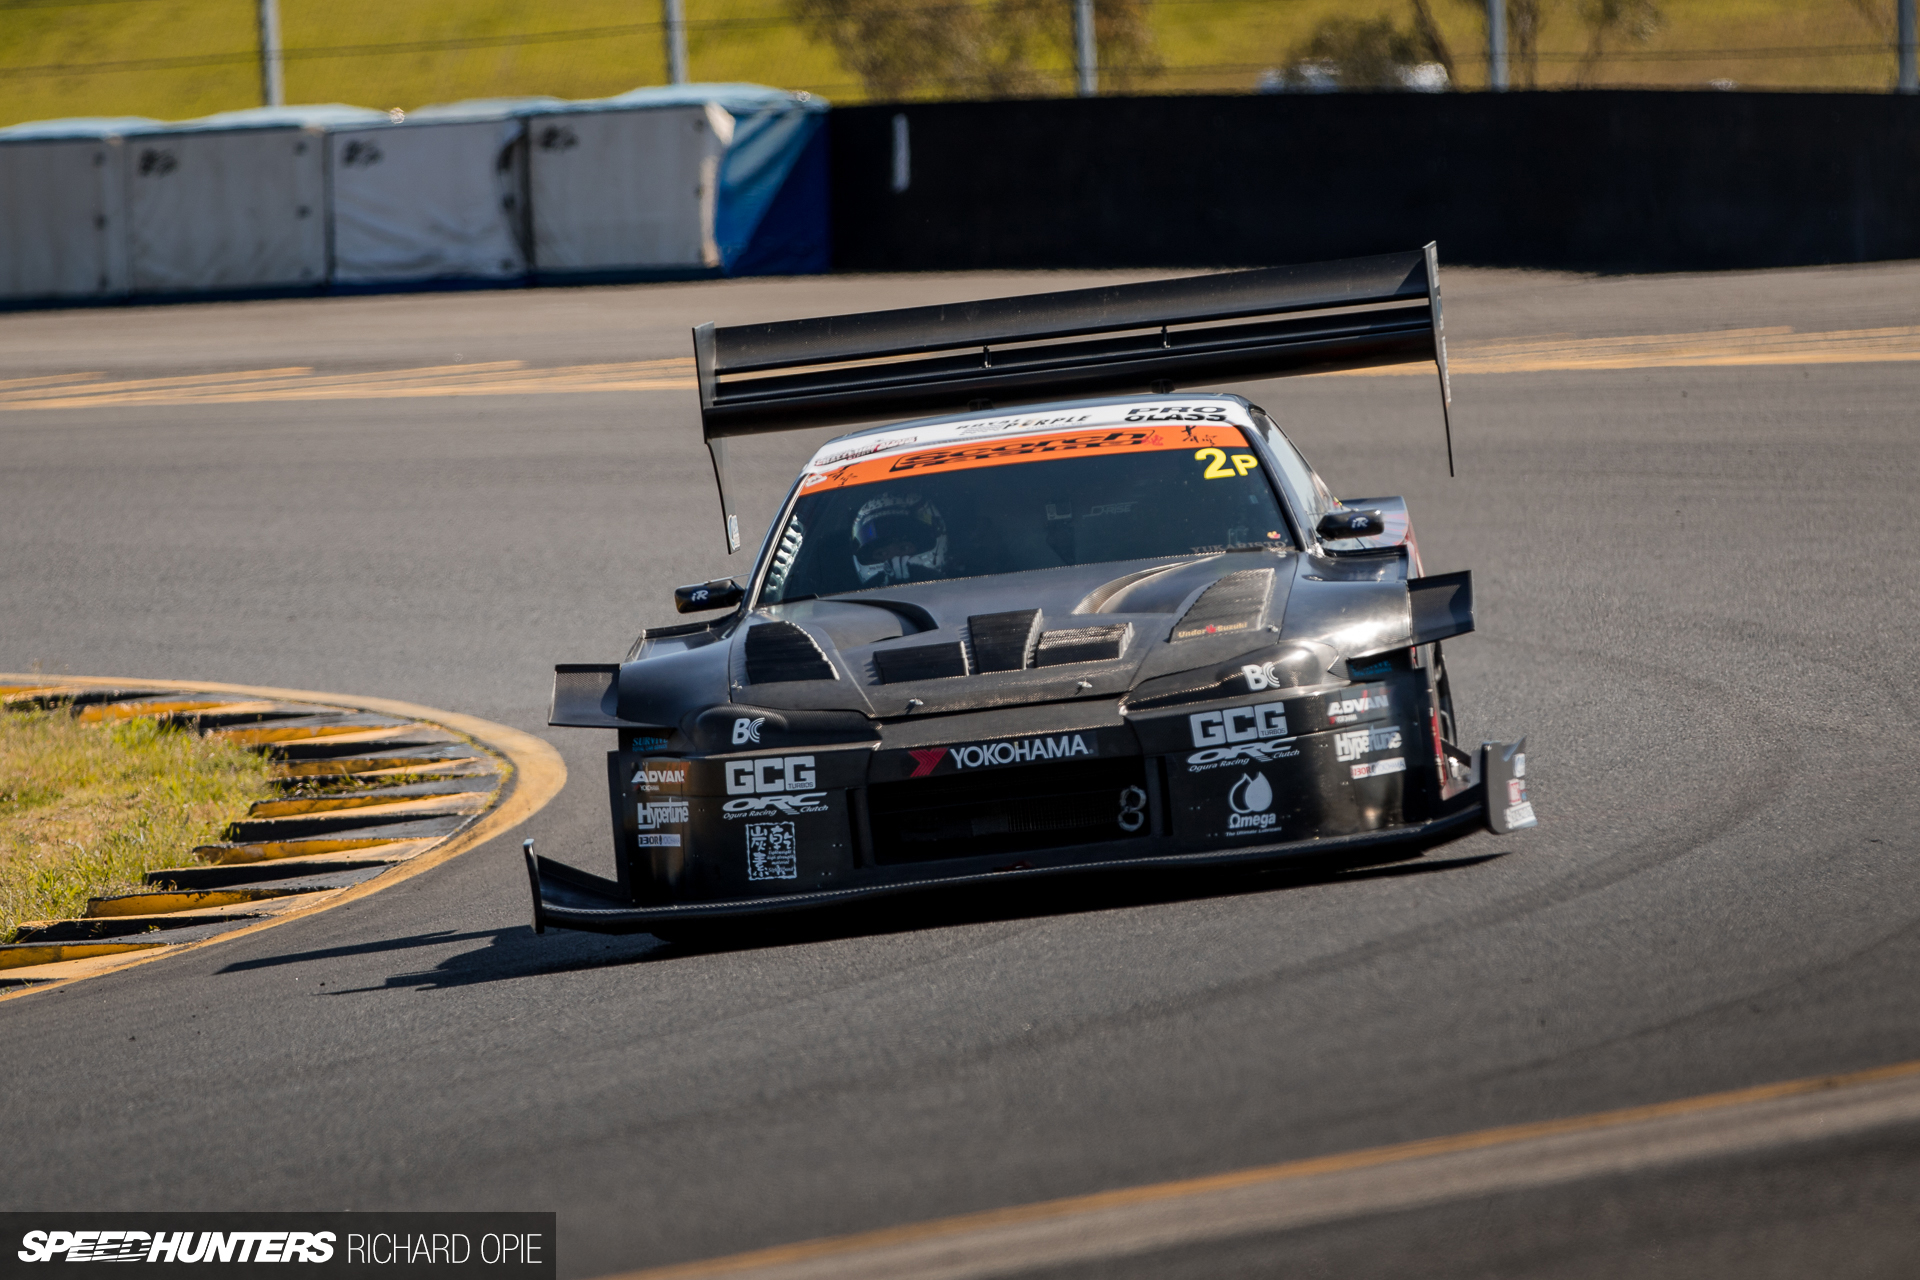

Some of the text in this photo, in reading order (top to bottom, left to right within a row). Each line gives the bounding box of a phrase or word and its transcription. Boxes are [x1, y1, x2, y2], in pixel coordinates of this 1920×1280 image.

[1003, 414, 1092, 430] PURPLE
[1124, 414, 1228, 422] CLASS
[1127, 406, 1227, 415] PRO
[1194, 447, 1259, 480] 2P
[1327, 694, 1390, 716] ADVAN
[1190, 701, 1288, 748] GCG
[1261, 727, 1286, 736] TURBOS
[950, 734, 1089, 769] YOKOHAMA
[1187, 736, 1298, 763] ORC
[1334, 724, 1402, 762] Hypertune
[1188, 749, 1300, 772] Ogura Racing Clutch
[631, 769, 685, 783] ADVAN
[725, 755, 816, 795] GCG
[637, 797, 689, 830] Hypertune
[723, 792, 828, 815] ORC
[723, 804, 829, 820] Ogura Racing Clutch
